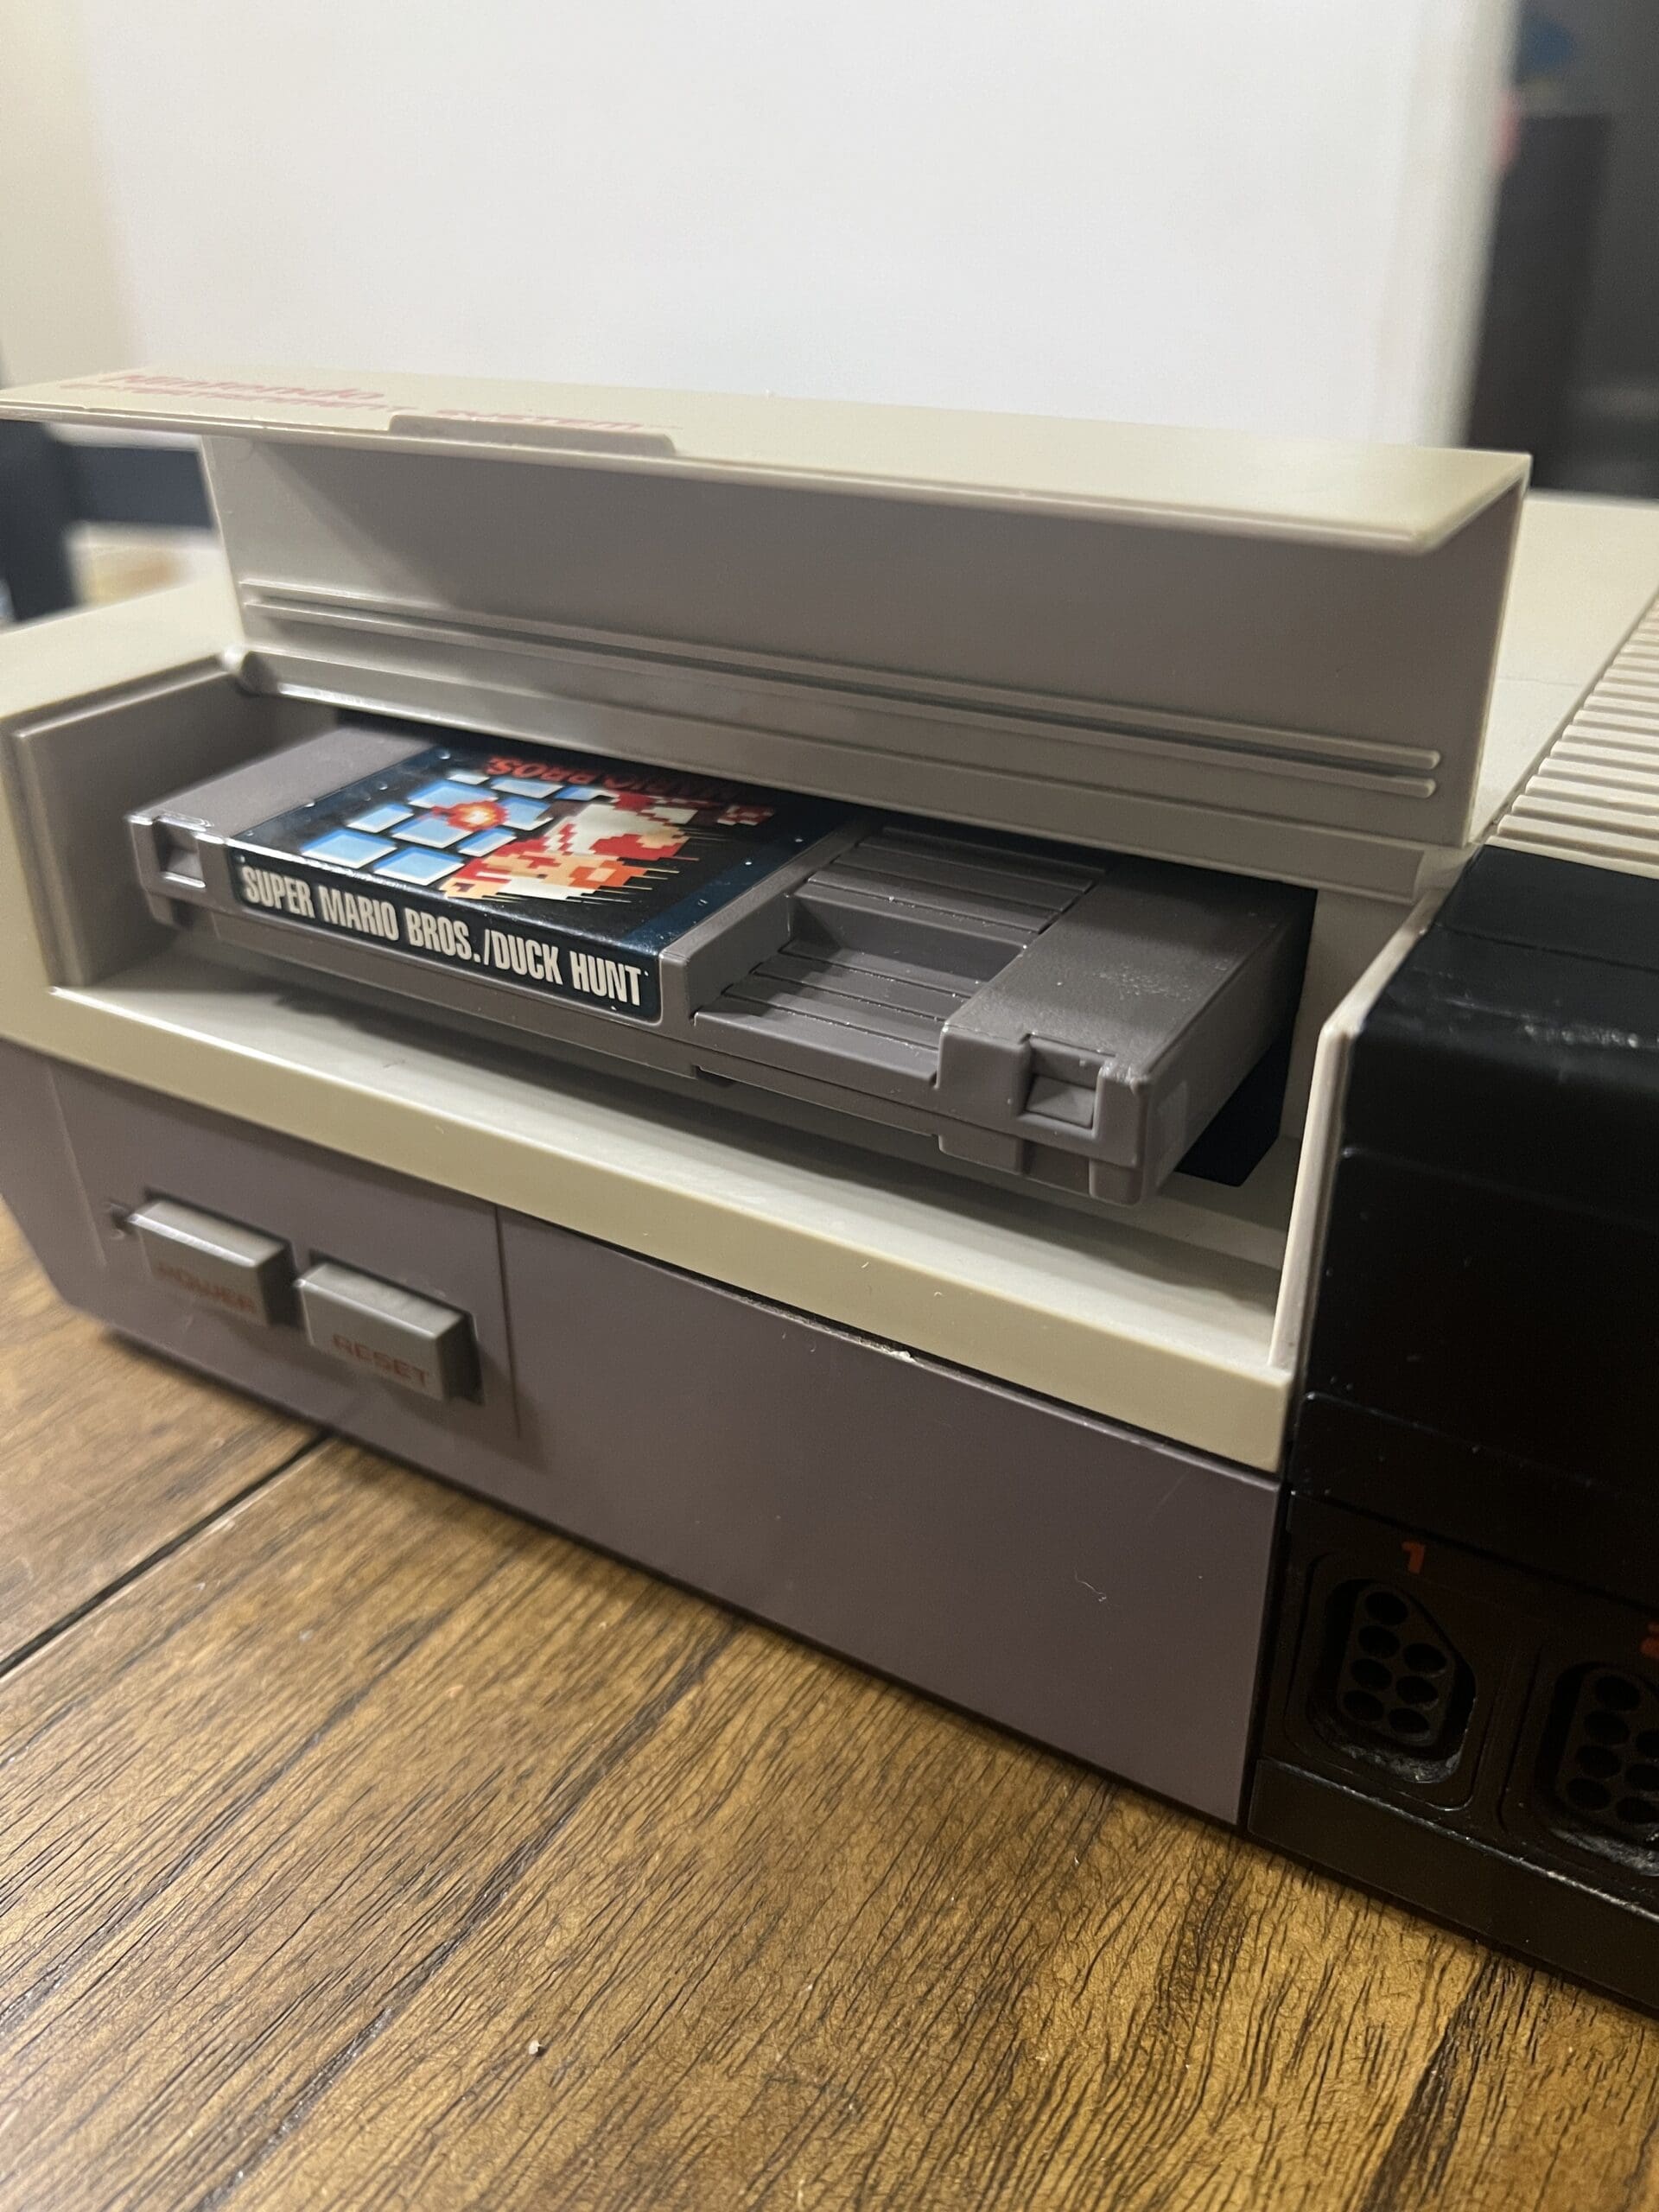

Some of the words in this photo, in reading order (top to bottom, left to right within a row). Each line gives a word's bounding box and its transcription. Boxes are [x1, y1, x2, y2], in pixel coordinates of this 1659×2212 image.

[241, 866, 315, 918] SUPER
[317, 884, 400, 942] MARIO
[569, 950, 642, 1007] HUNT
[156, 1261, 257, 1314] POWER
[331, 1333, 430, 1387] RESET
[1402, 1541, 1426, 1574] 1
